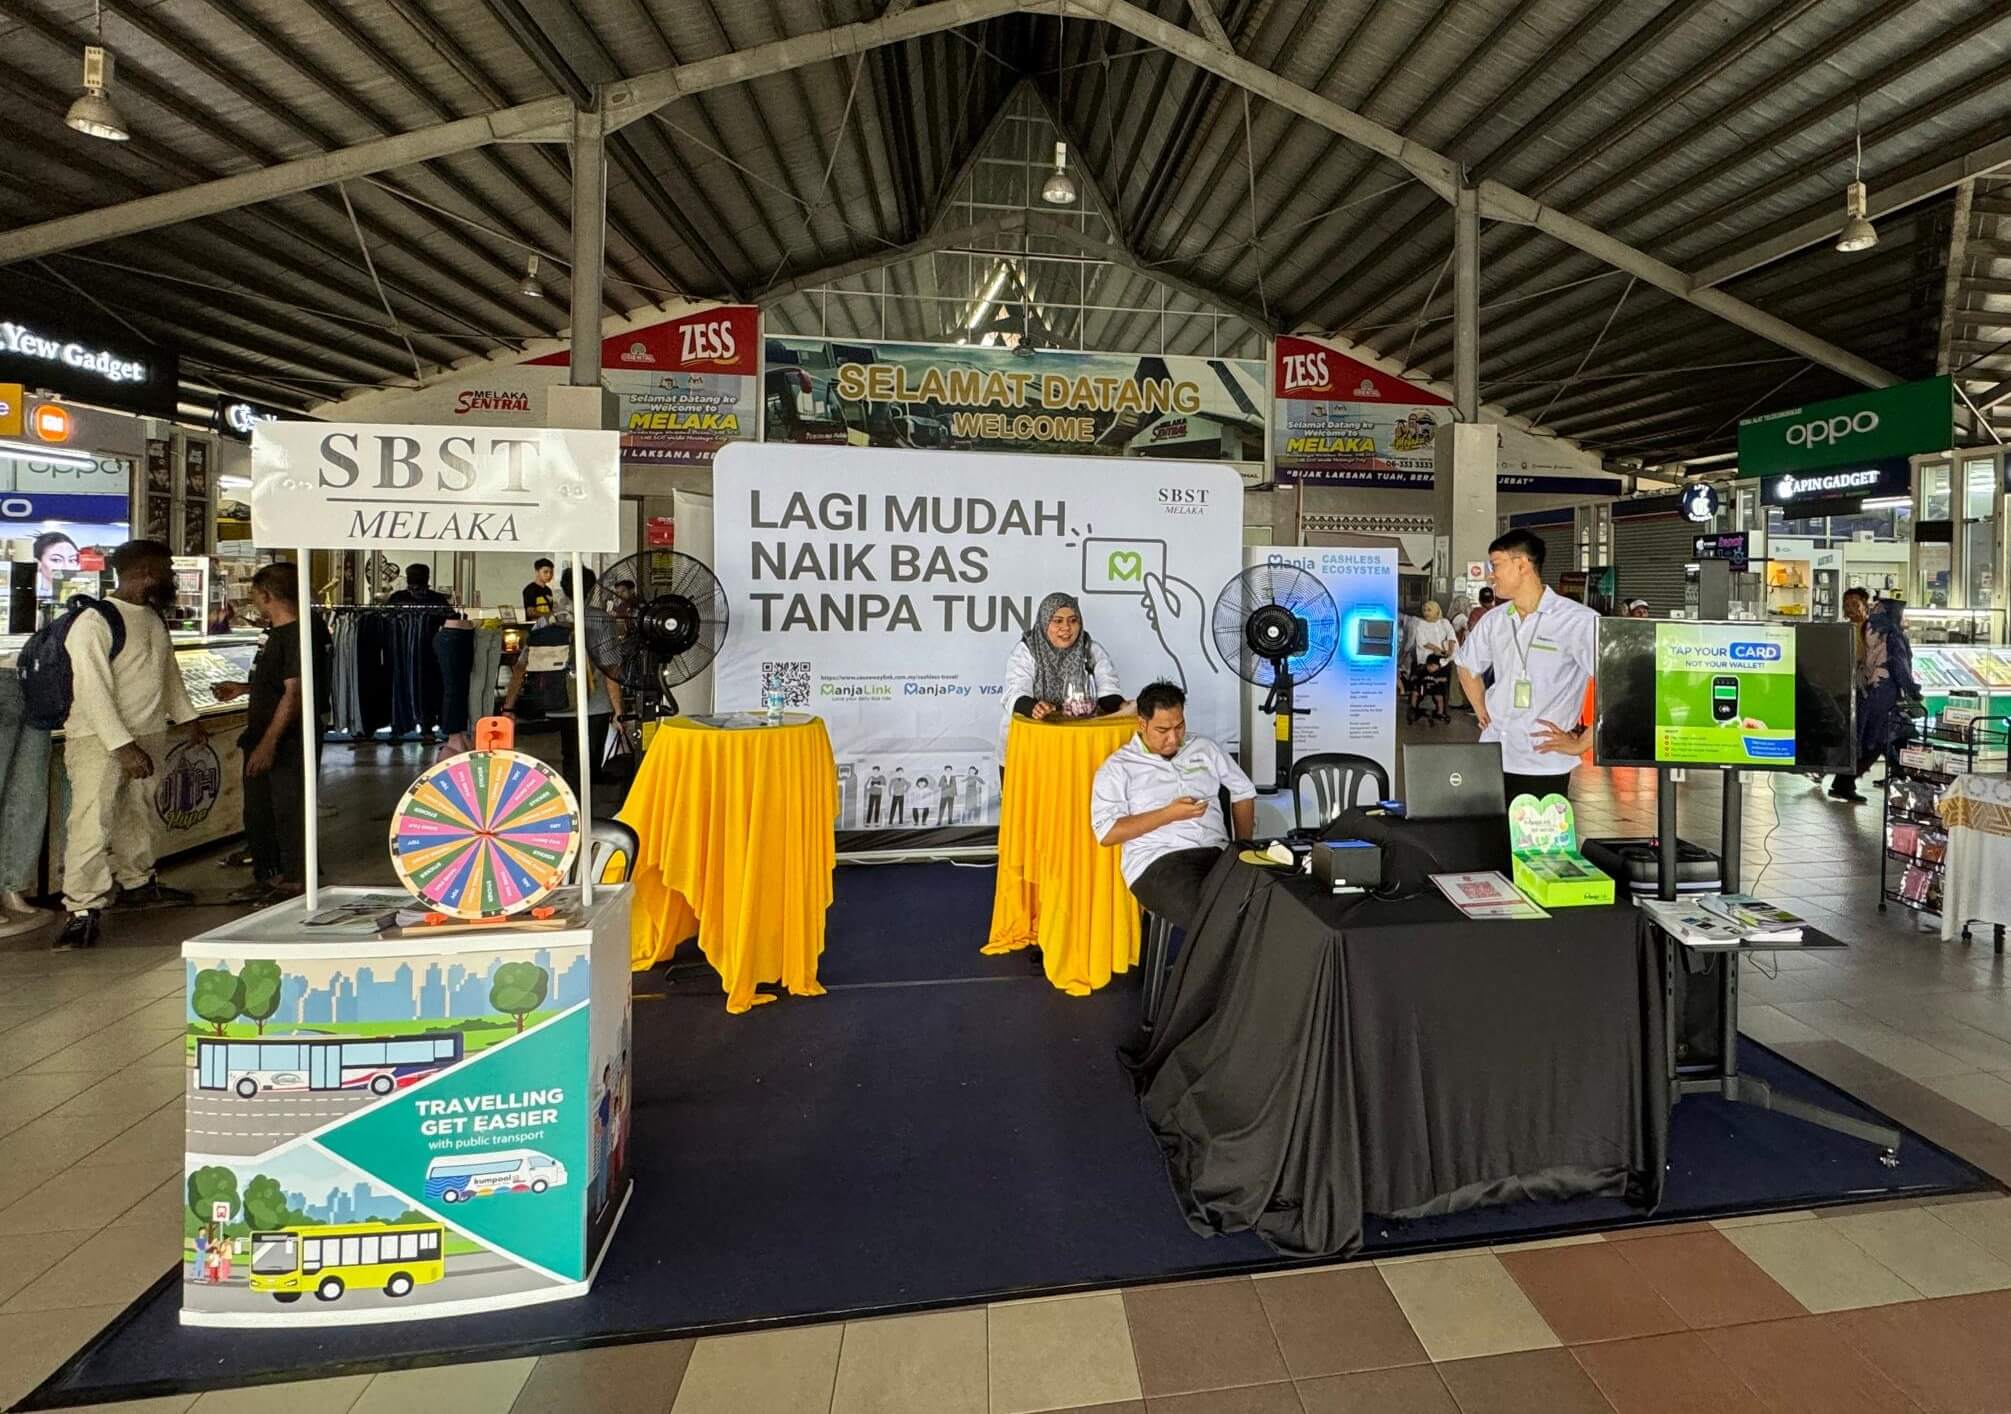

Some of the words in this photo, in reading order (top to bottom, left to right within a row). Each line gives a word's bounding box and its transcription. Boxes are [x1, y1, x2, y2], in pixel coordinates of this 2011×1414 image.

[679, 321, 736, 361] ZESS
[62, 343, 145, 381] Gadget
[1283, 352, 1329, 389] ZESS
[474, 390, 528, 399] MELAKA
[630, 394, 676, 403] Selamat
[680, 395, 720, 405] Datang
[839, 363, 1031, 407] SELAMAT
[1042, 374, 1201, 415] DATANG
[454, 391, 531, 414] SENTRAL
[650, 404, 703, 412] Welcome
[629, 413, 738, 429] MELAKA
[953, 414, 1096, 443] WELCOME
[1288, 422, 1325, 430] Selamat
[1328, 422, 1360, 430] Datang
[1786, 411, 1879, 448] oppo
[632, 450, 690, 459] LAKSANA
[1287, 438, 1376, 452] MELAKA
[319, 433, 539, 493] SBST
[1793, 480, 1823, 493] APIN
[1823, 470, 1880, 489] GADGET
[1158, 488, 1209, 503] SBST
[750, 490, 867, 532] LAGI
[885, 495, 1066, 537] MUDAH
[1165, 506, 1204, 515] MELAKA
[348, 509, 520, 542] MELAKA
[752, 541, 876, 582] NAIK
[890, 545, 989, 584] BAS
[1322, 555, 1381, 564] CASHLESS
[1322, 565, 1391, 575] ECOSYSTEM
[749, 593, 922, 633] TANPA
[932, 594, 1034, 634] TUN
[1671, 646, 1693, 656] TAP
[1695, 647, 1727, 657] YOUR
[1735, 645, 1777, 659] CARD
[820, 683, 892, 696] ManjaLink
[904, 683, 972, 696] ManjaPay
[979, 685, 1004, 695] VISA
[415, 1088, 564, 1116] TRAVELLING
[421, 1117, 467, 1136] GET
[474, 1109, 558, 1132] EASIER
[428, 1138, 453, 1150] with
[456, 1134, 490, 1149] public
[493, 1130, 544, 1146] transport
